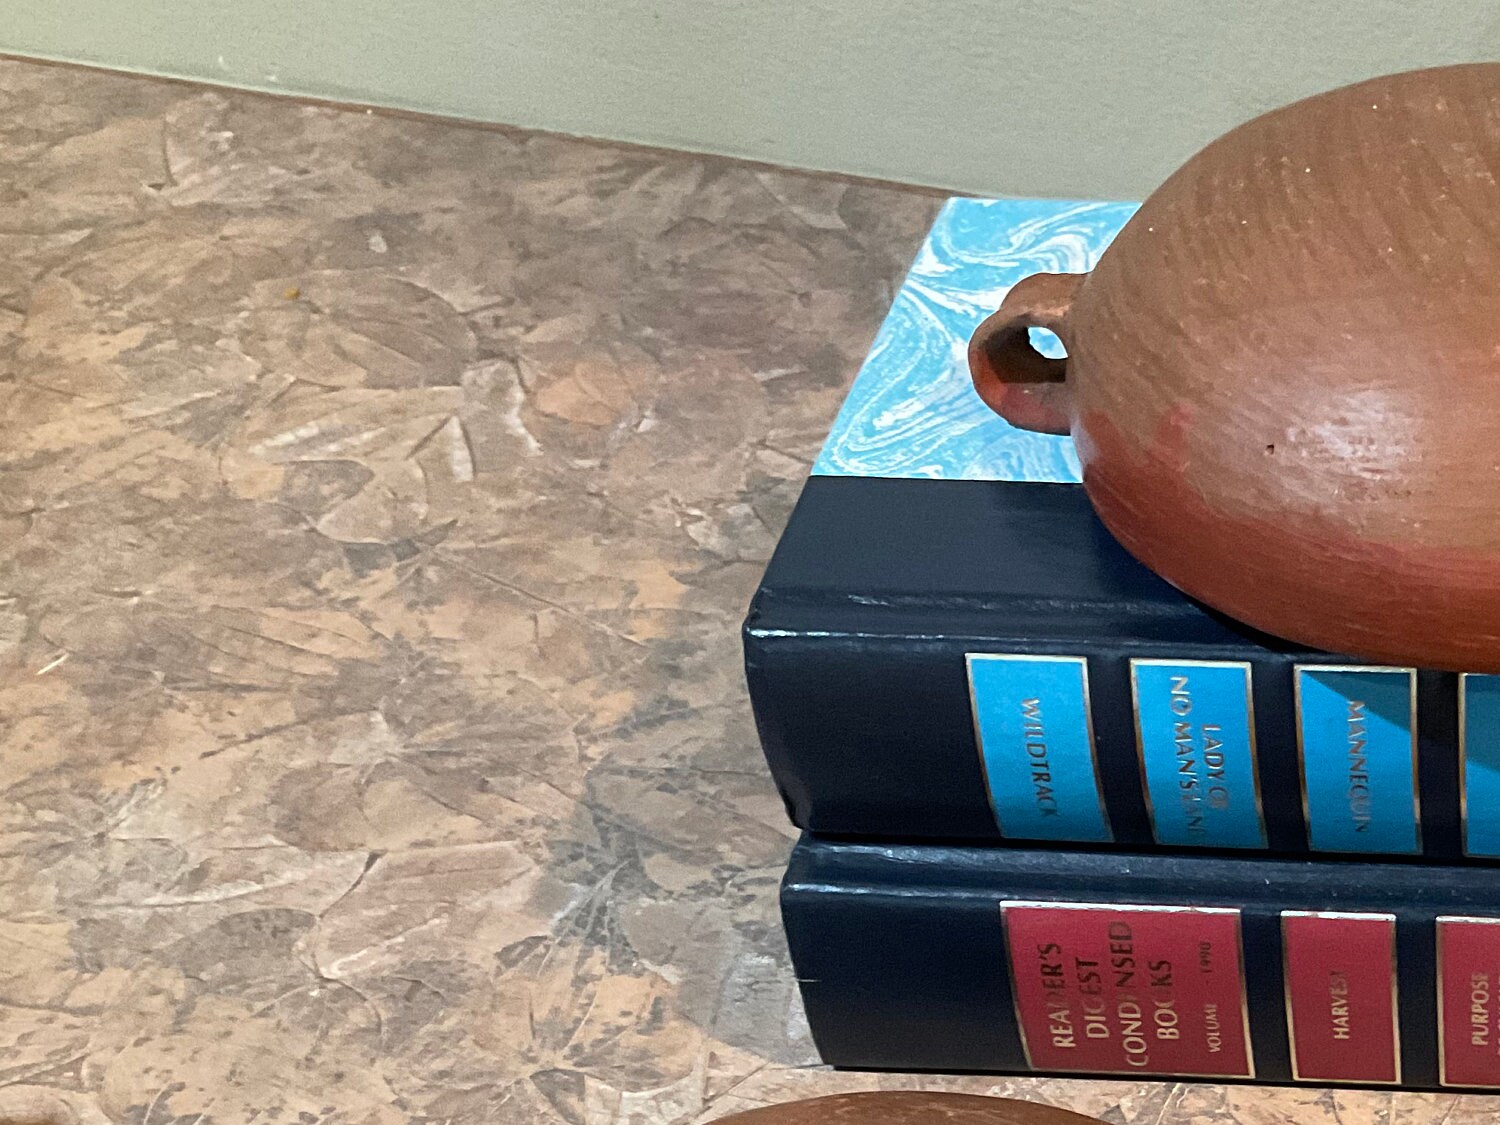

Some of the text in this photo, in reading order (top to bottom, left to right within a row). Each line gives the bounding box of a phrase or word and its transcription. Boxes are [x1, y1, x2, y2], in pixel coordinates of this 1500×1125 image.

[1169, 675, 1192, 716] NO
[1020, 698, 1060, 817] WILDTRACK
[1174, 721, 1199, 791] MAN'S
[1328, 970, 1350, 1040] HARVEST
[1471, 971, 1490, 1046] PURPOSE
